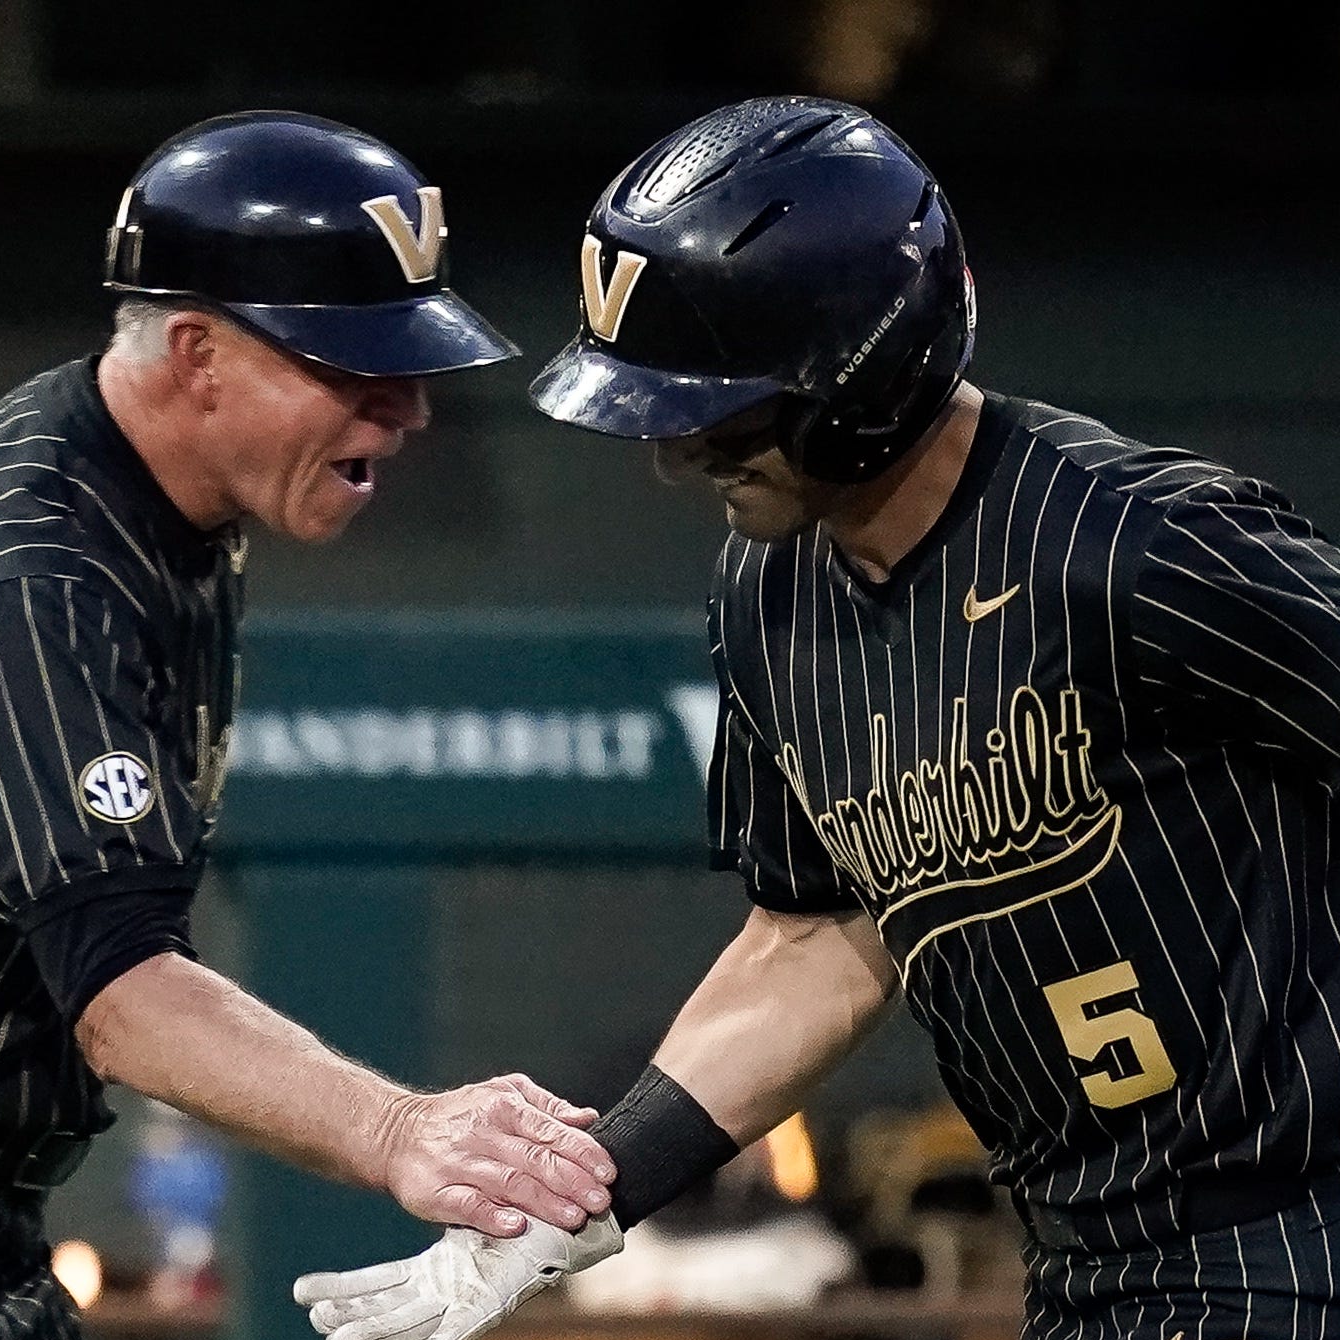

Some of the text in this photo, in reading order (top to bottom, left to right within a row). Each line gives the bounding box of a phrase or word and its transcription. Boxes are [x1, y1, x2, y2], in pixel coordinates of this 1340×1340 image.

[361, 186, 443, 283] V
[581, 234, 648, 342] V
[83, 755, 152, 818] SEC
[1042, 959, 1178, 1110] 5
